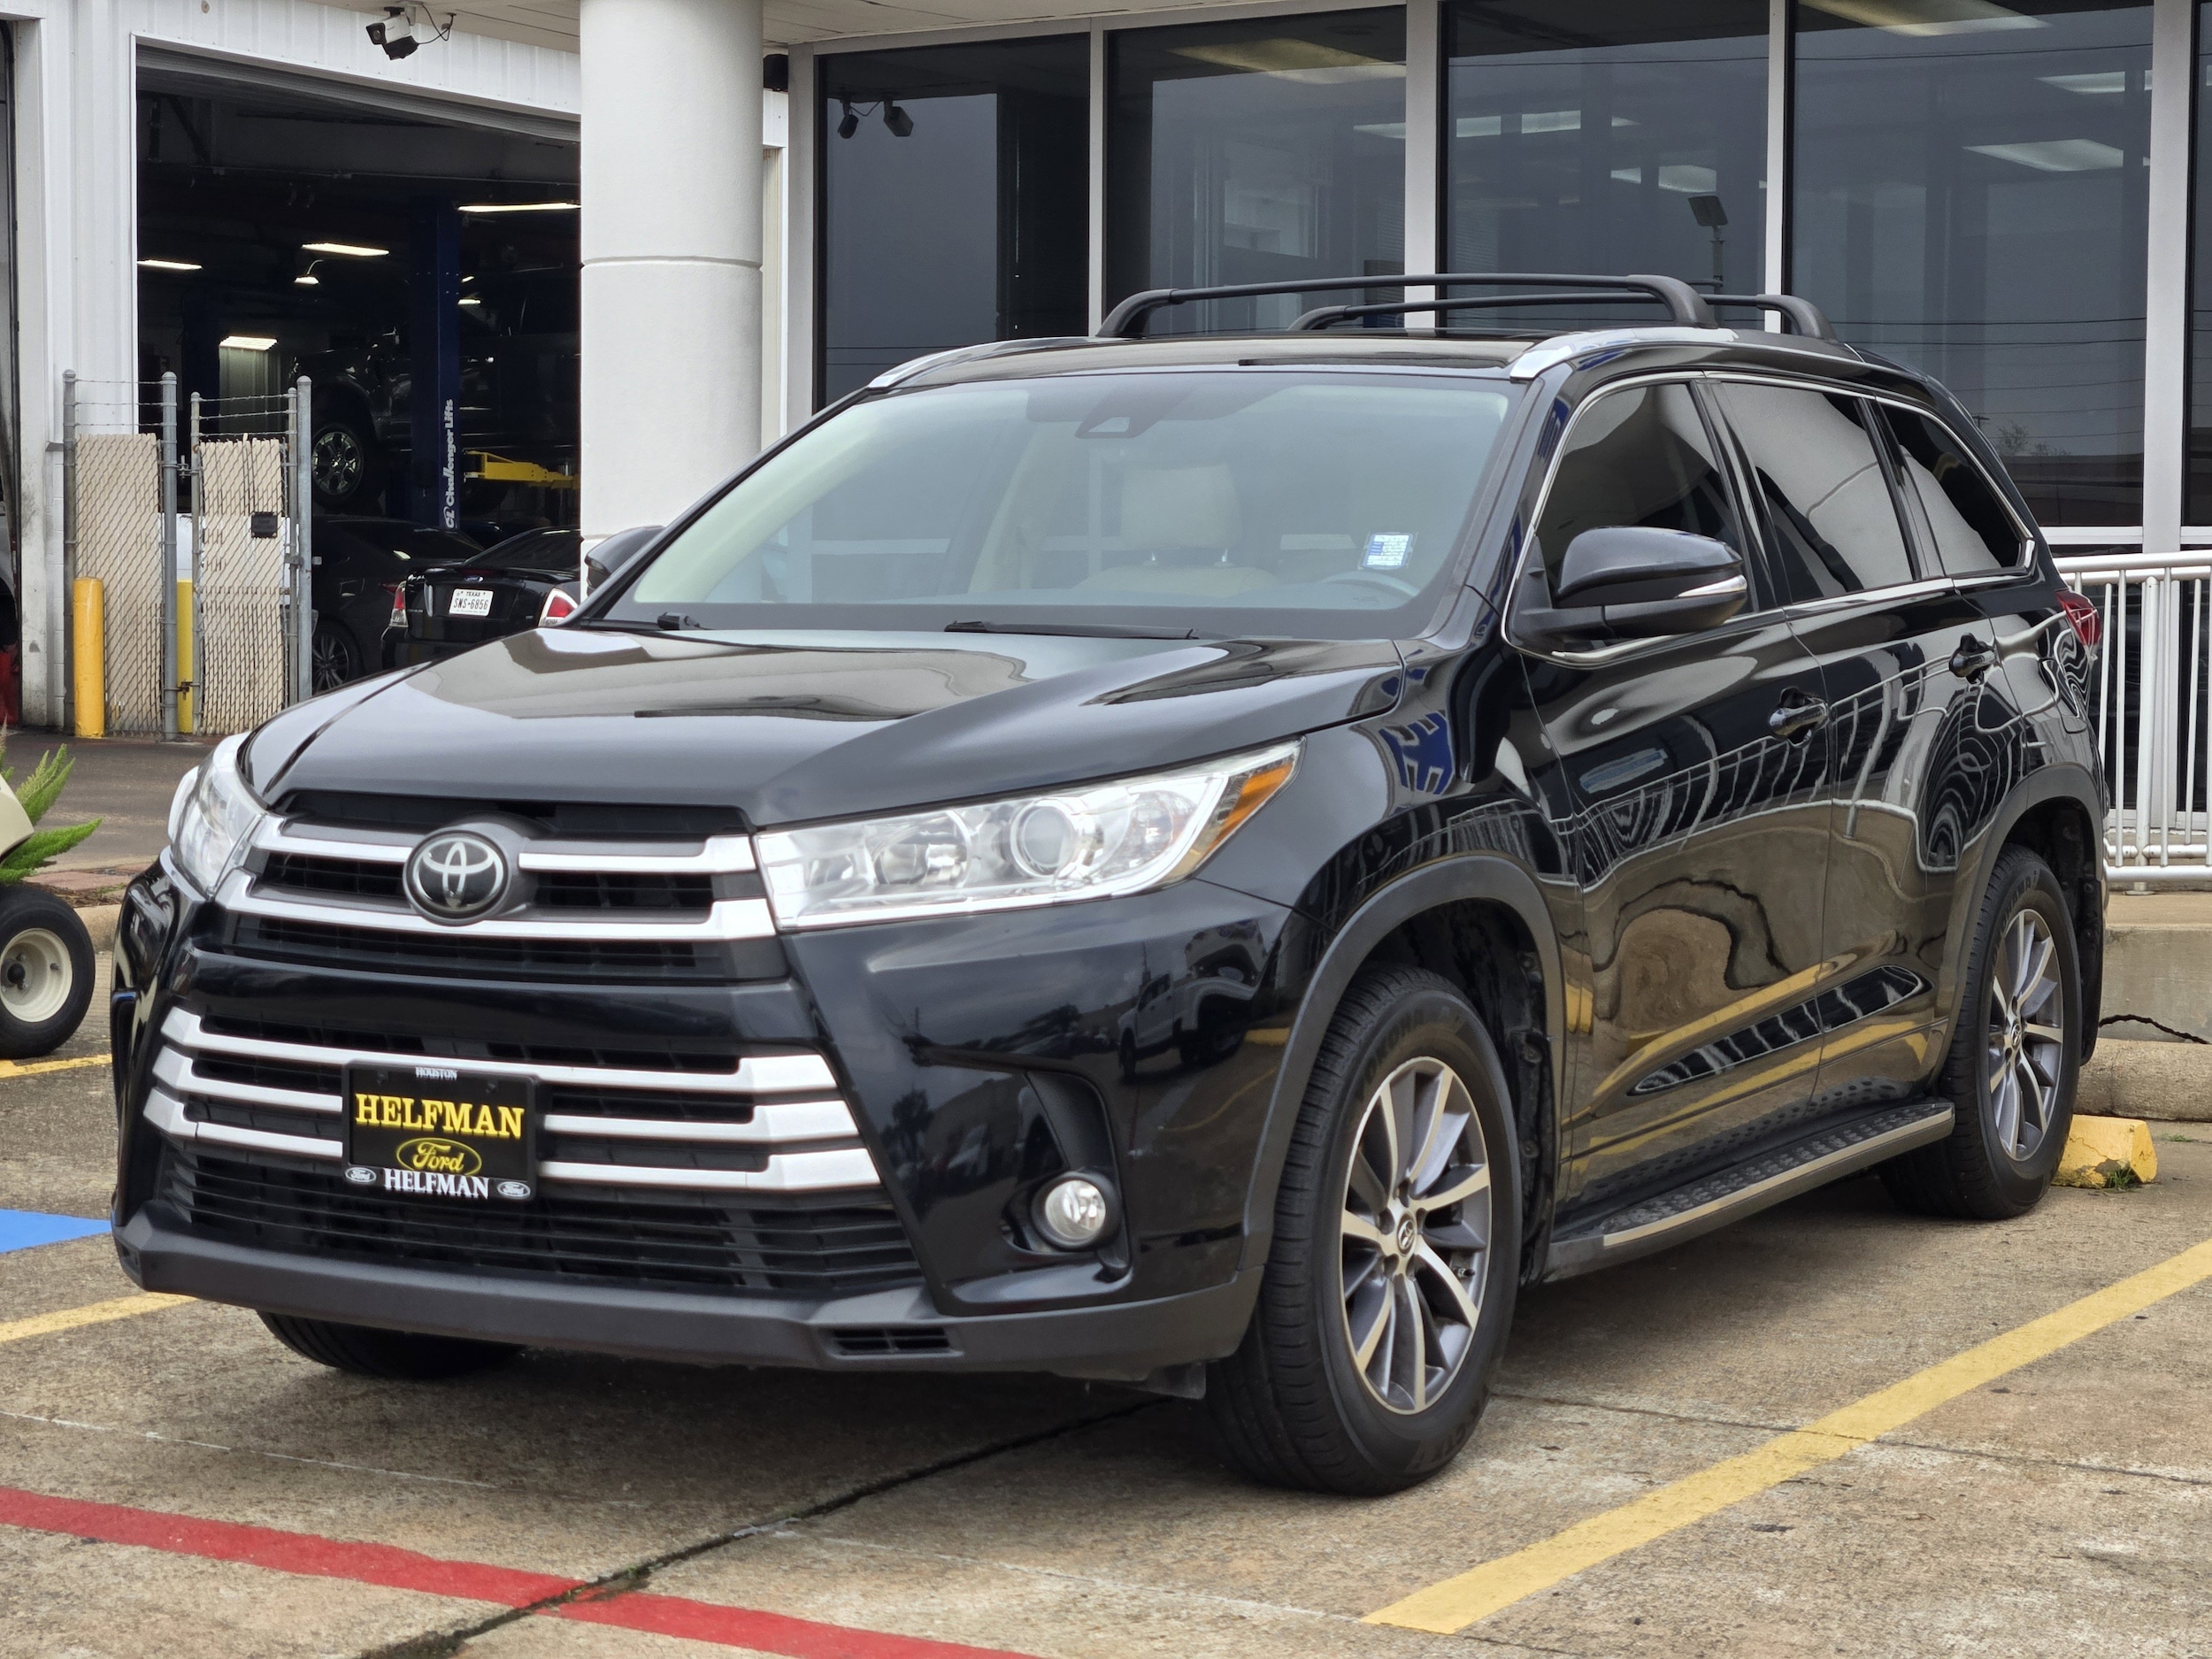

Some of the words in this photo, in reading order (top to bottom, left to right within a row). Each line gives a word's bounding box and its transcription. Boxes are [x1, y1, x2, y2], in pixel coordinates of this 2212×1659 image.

[443, 398, 455, 429] Lifts
[443, 430, 457, 506] Challenger
[415, 1066, 458, 1081] HOUSTON
[355, 1093, 526, 1140] HELFMAN
[412, 1141, 465, 1172] Ford
[383, 1167, 490, 1200] HELFMAN
